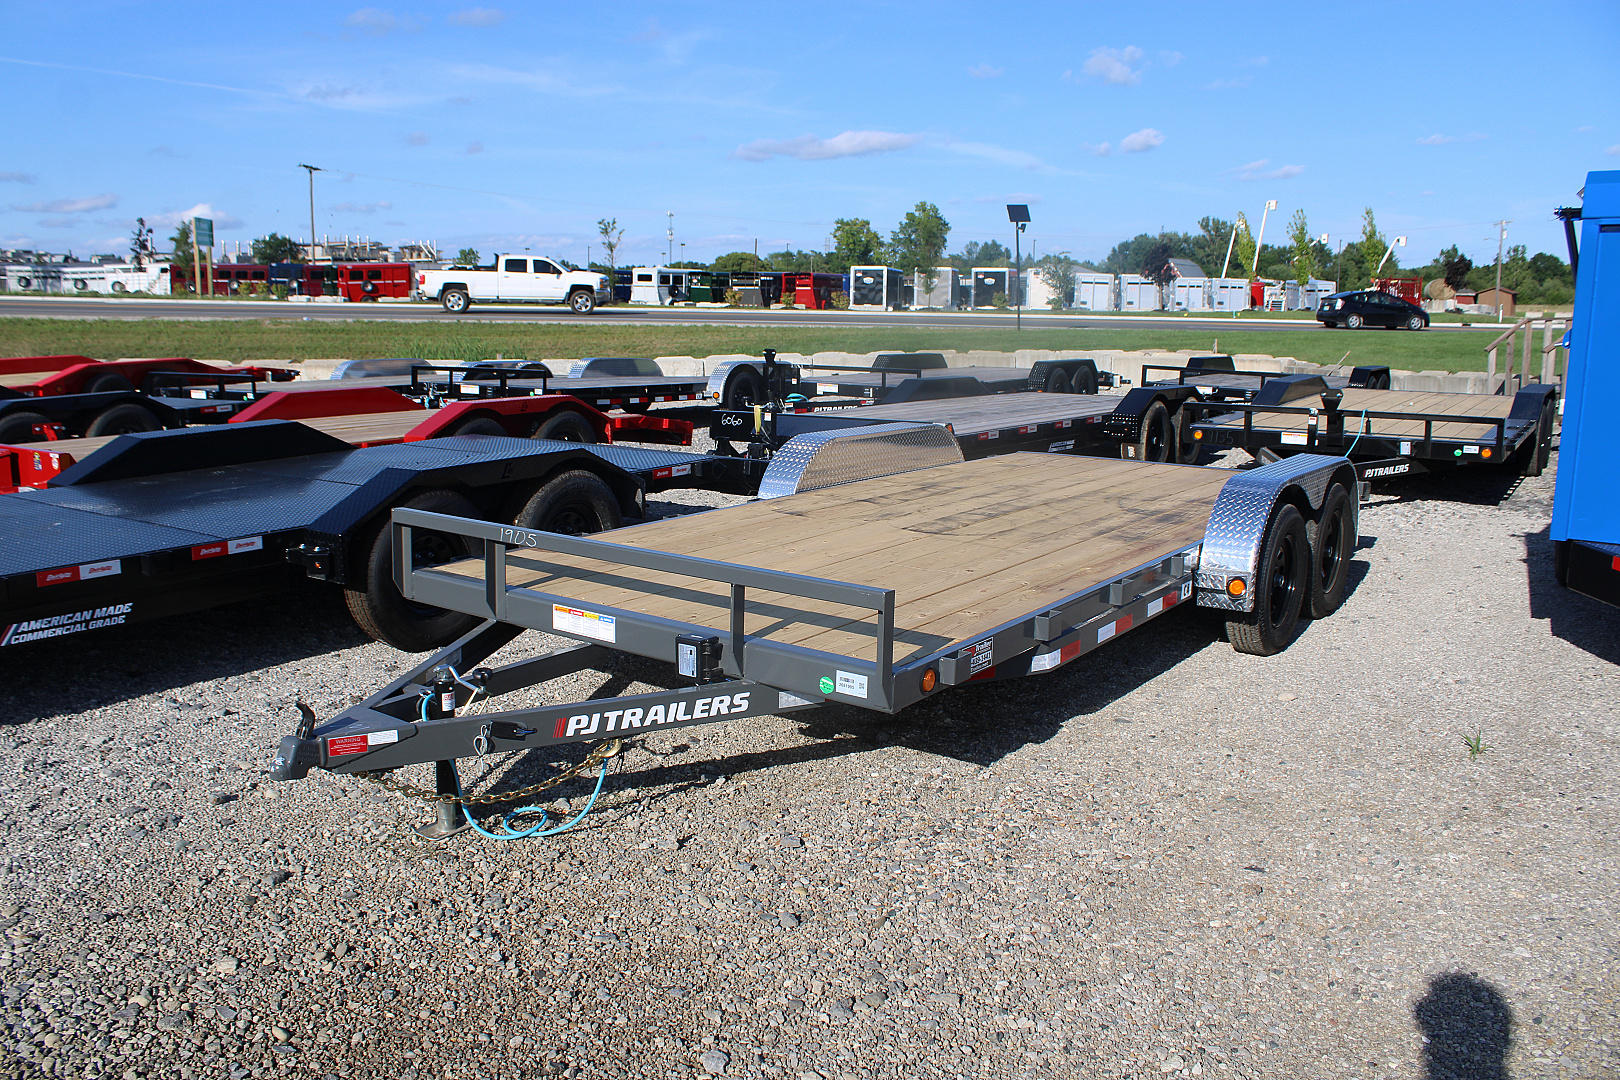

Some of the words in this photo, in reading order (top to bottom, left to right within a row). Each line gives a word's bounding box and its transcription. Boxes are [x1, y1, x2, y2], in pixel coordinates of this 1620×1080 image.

[721, 413, 743, 426] 6060
[1373, 463, 1410, 476] TRAILERS
[500, 527, 538, 548] 1905
[16, 609, 92, 633] AMERICAN
[93, 602, 134, 619] MADE
[10, 621, 88, 645] COMMERCIAL
[88, 615, 127, 630] GRADE
[564, 712, 602, 737] PJ
[603, 691, 751, 732] TRAILERS
[335, 736, 361, 745] WARNING
